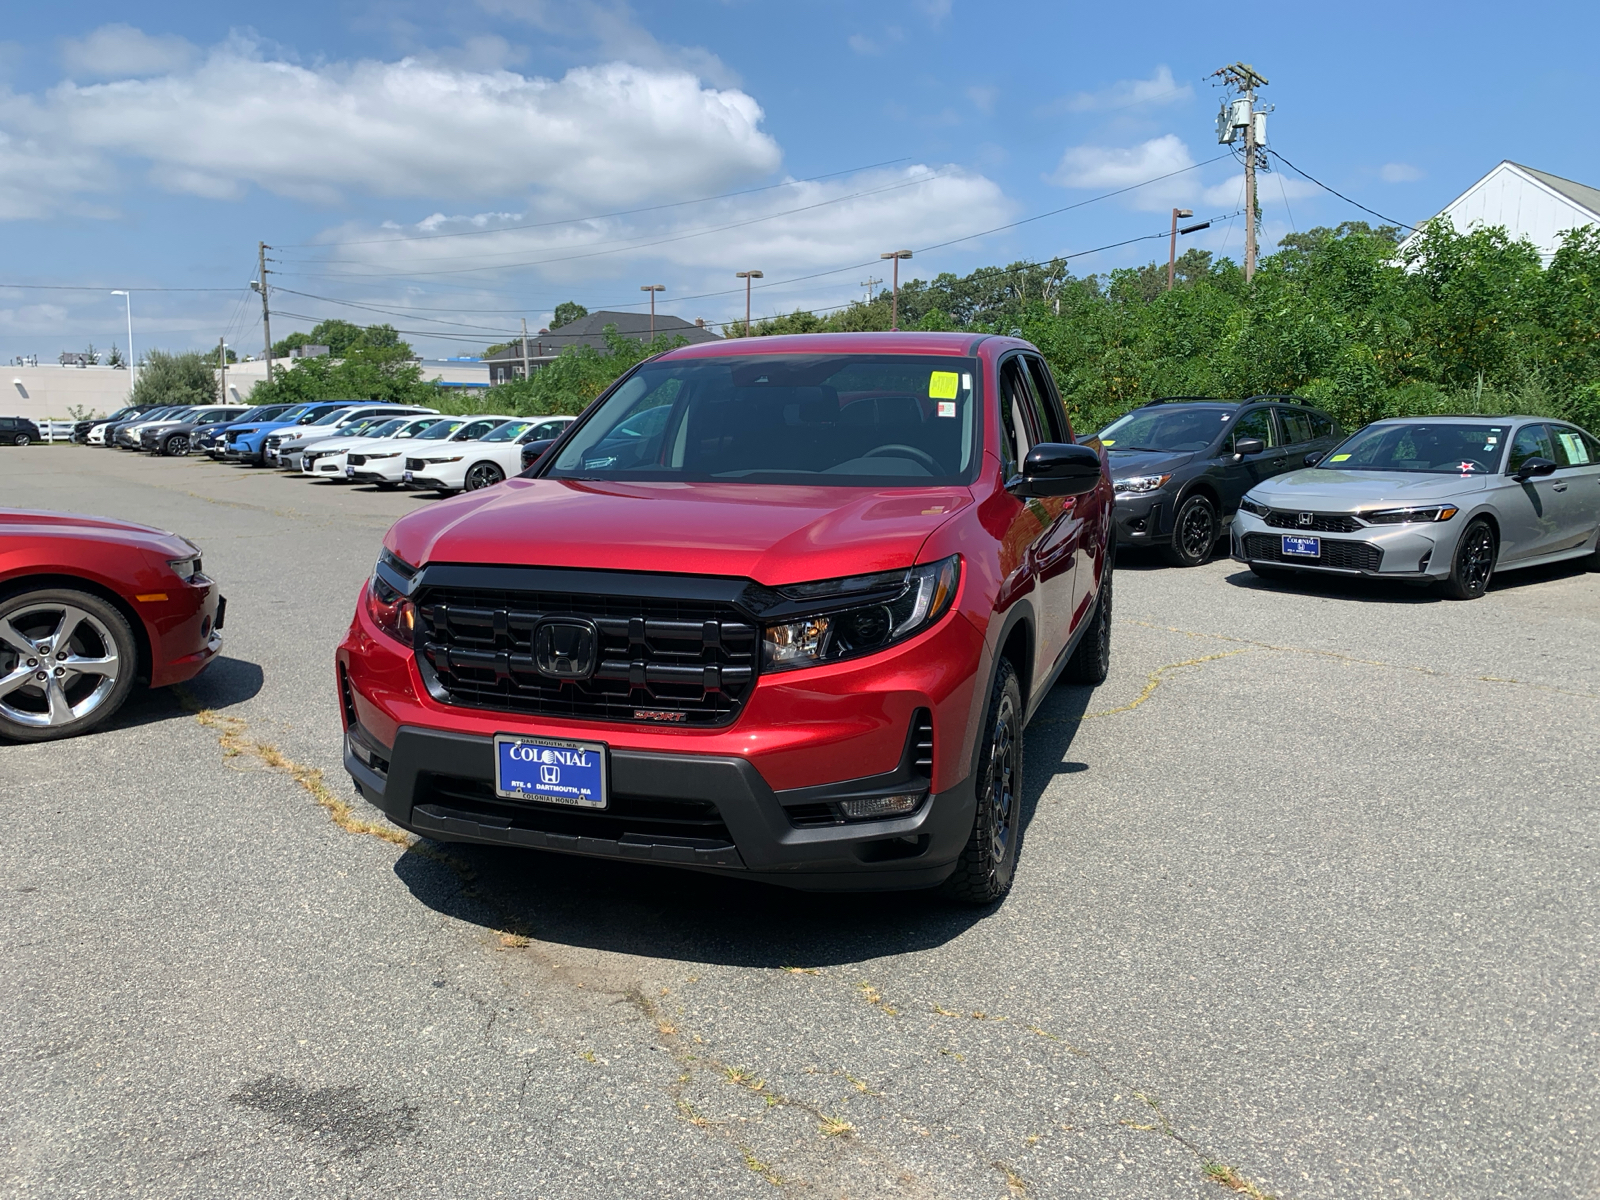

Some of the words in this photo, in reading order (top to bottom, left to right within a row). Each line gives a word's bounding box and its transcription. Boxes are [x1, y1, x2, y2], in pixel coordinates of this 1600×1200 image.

[634, 710, 686, 721] SPORT
[510, 746, 591, 767] COLONIAL
[536, 783, 579, 794] DARTMOUTH,
[581, 787, 591, 795] MA
[522, 793, 554, 803] COLONIAL
[555, 796, 579, 805] HONDA
